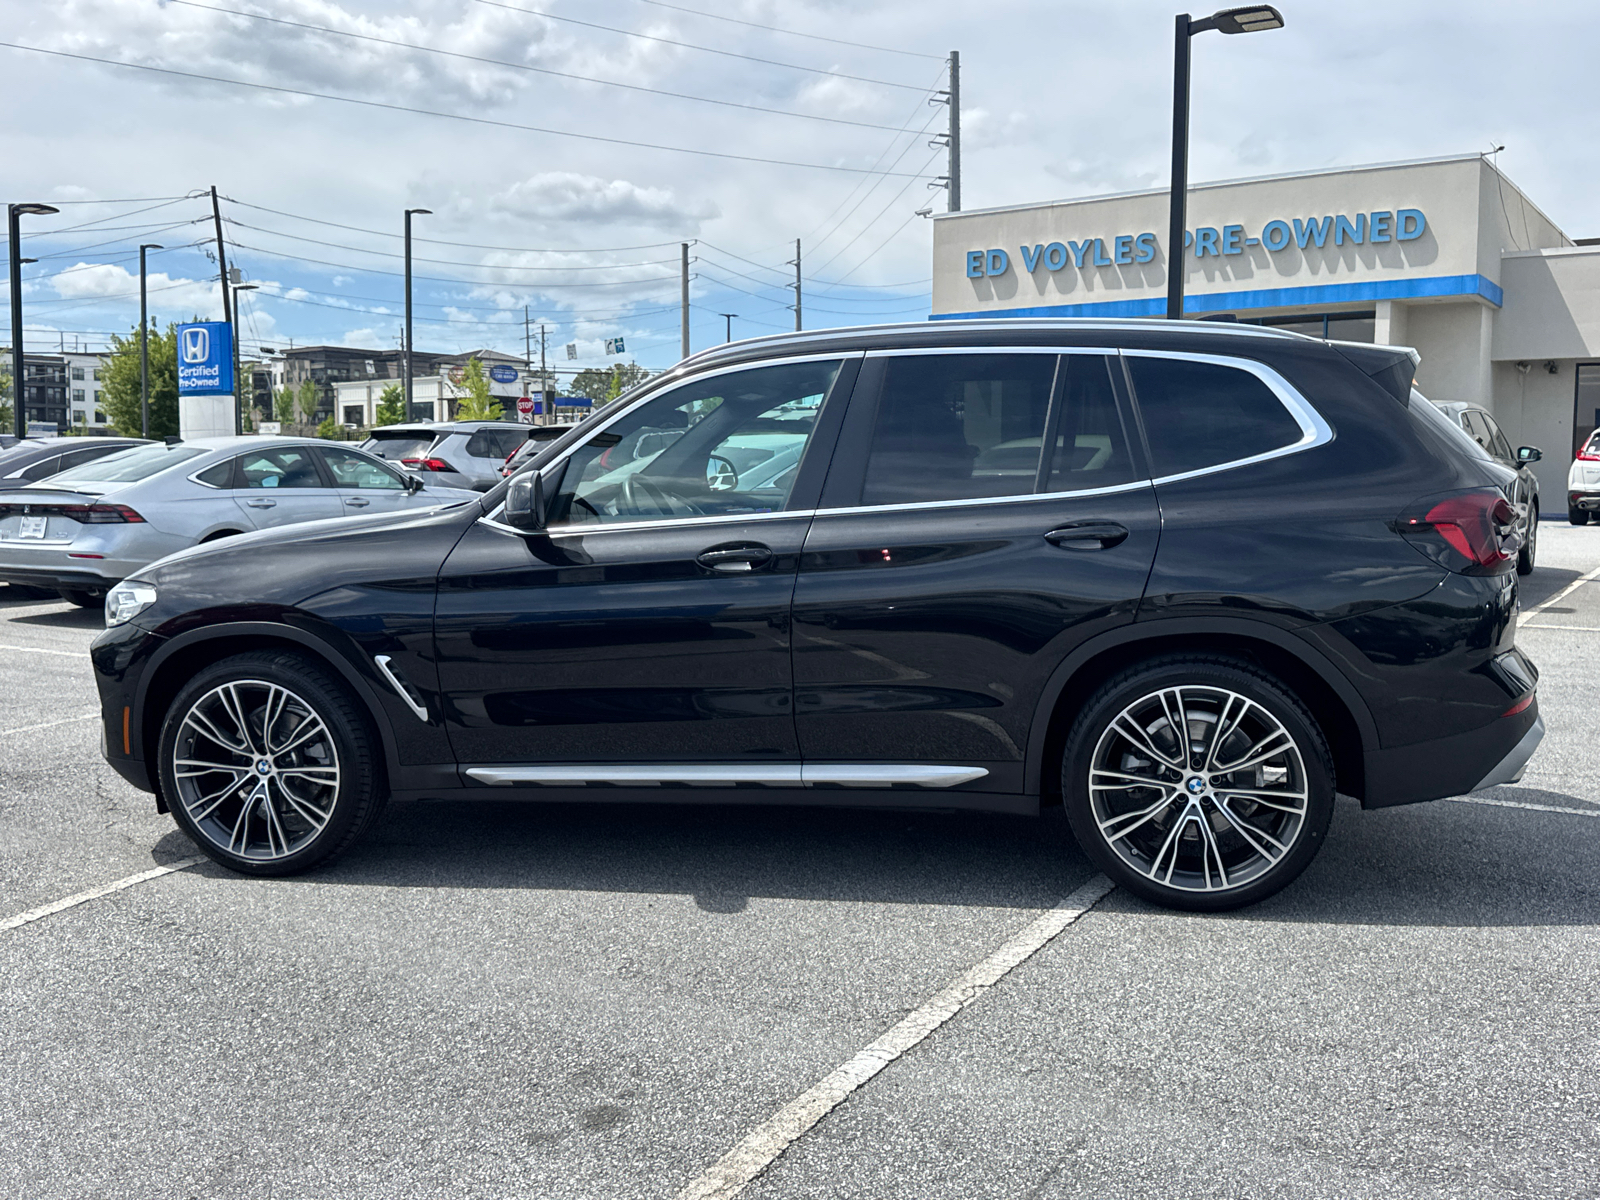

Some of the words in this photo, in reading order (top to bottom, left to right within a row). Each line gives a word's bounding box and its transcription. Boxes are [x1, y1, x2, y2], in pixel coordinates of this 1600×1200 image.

[966, 249, 1008, 278] ED
[1020, 232, 1156, 274] VOYLES
[1184, 208, 1426, 257] RE-OWNED
[178, 364, 219, 377] Certified
[179, 377, 220, 387] Pre-Owned
[518, 402, 533, 410] STOP
